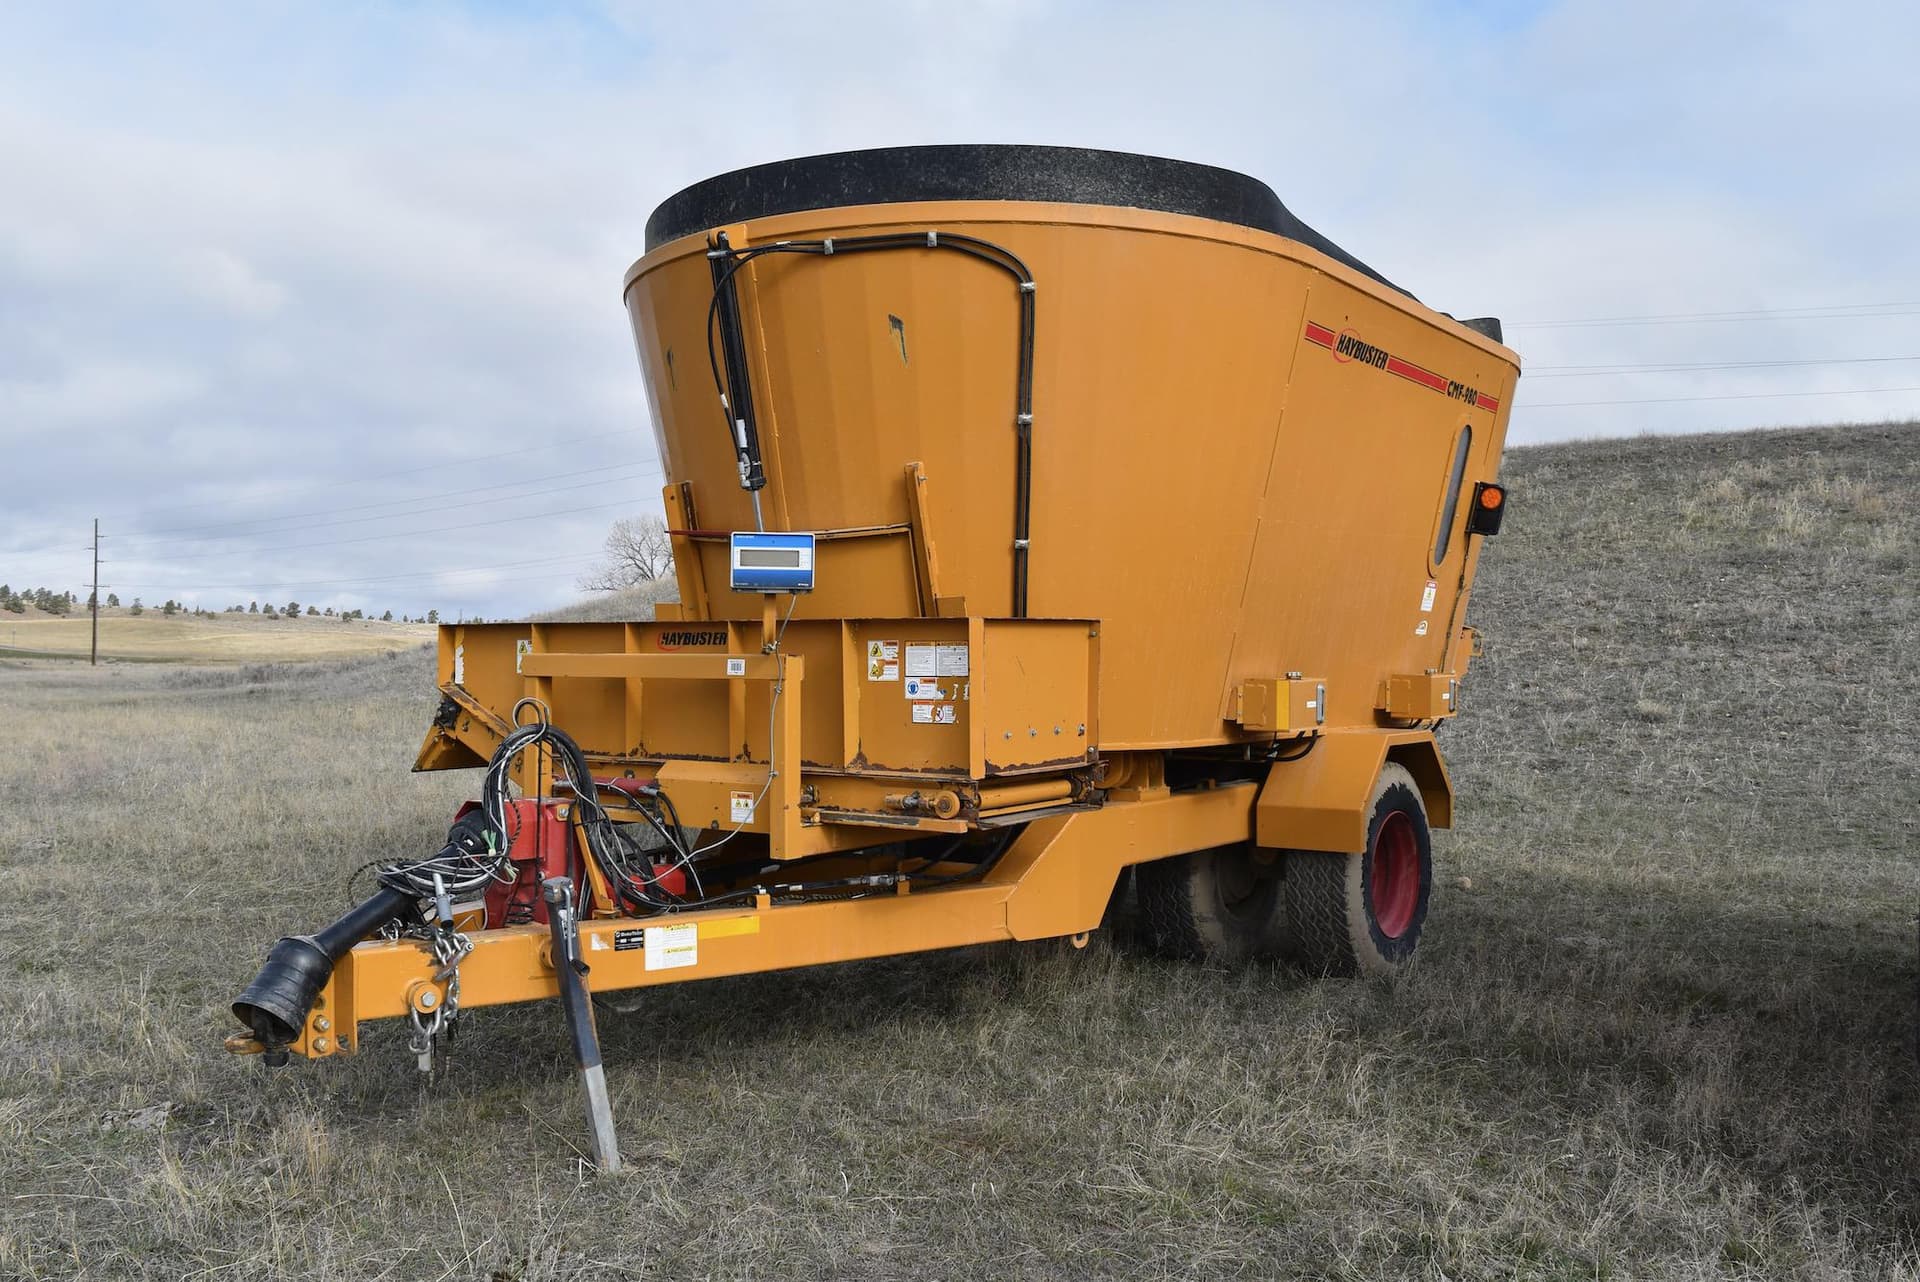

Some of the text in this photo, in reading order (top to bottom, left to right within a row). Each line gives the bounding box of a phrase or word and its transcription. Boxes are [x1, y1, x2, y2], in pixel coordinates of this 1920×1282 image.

[1335, 334, 1389, 370] HAYBUSTER
[1446, 380, 1478, 406] CMF-980
[661, 631, 728, 646] HAYBUSTER
